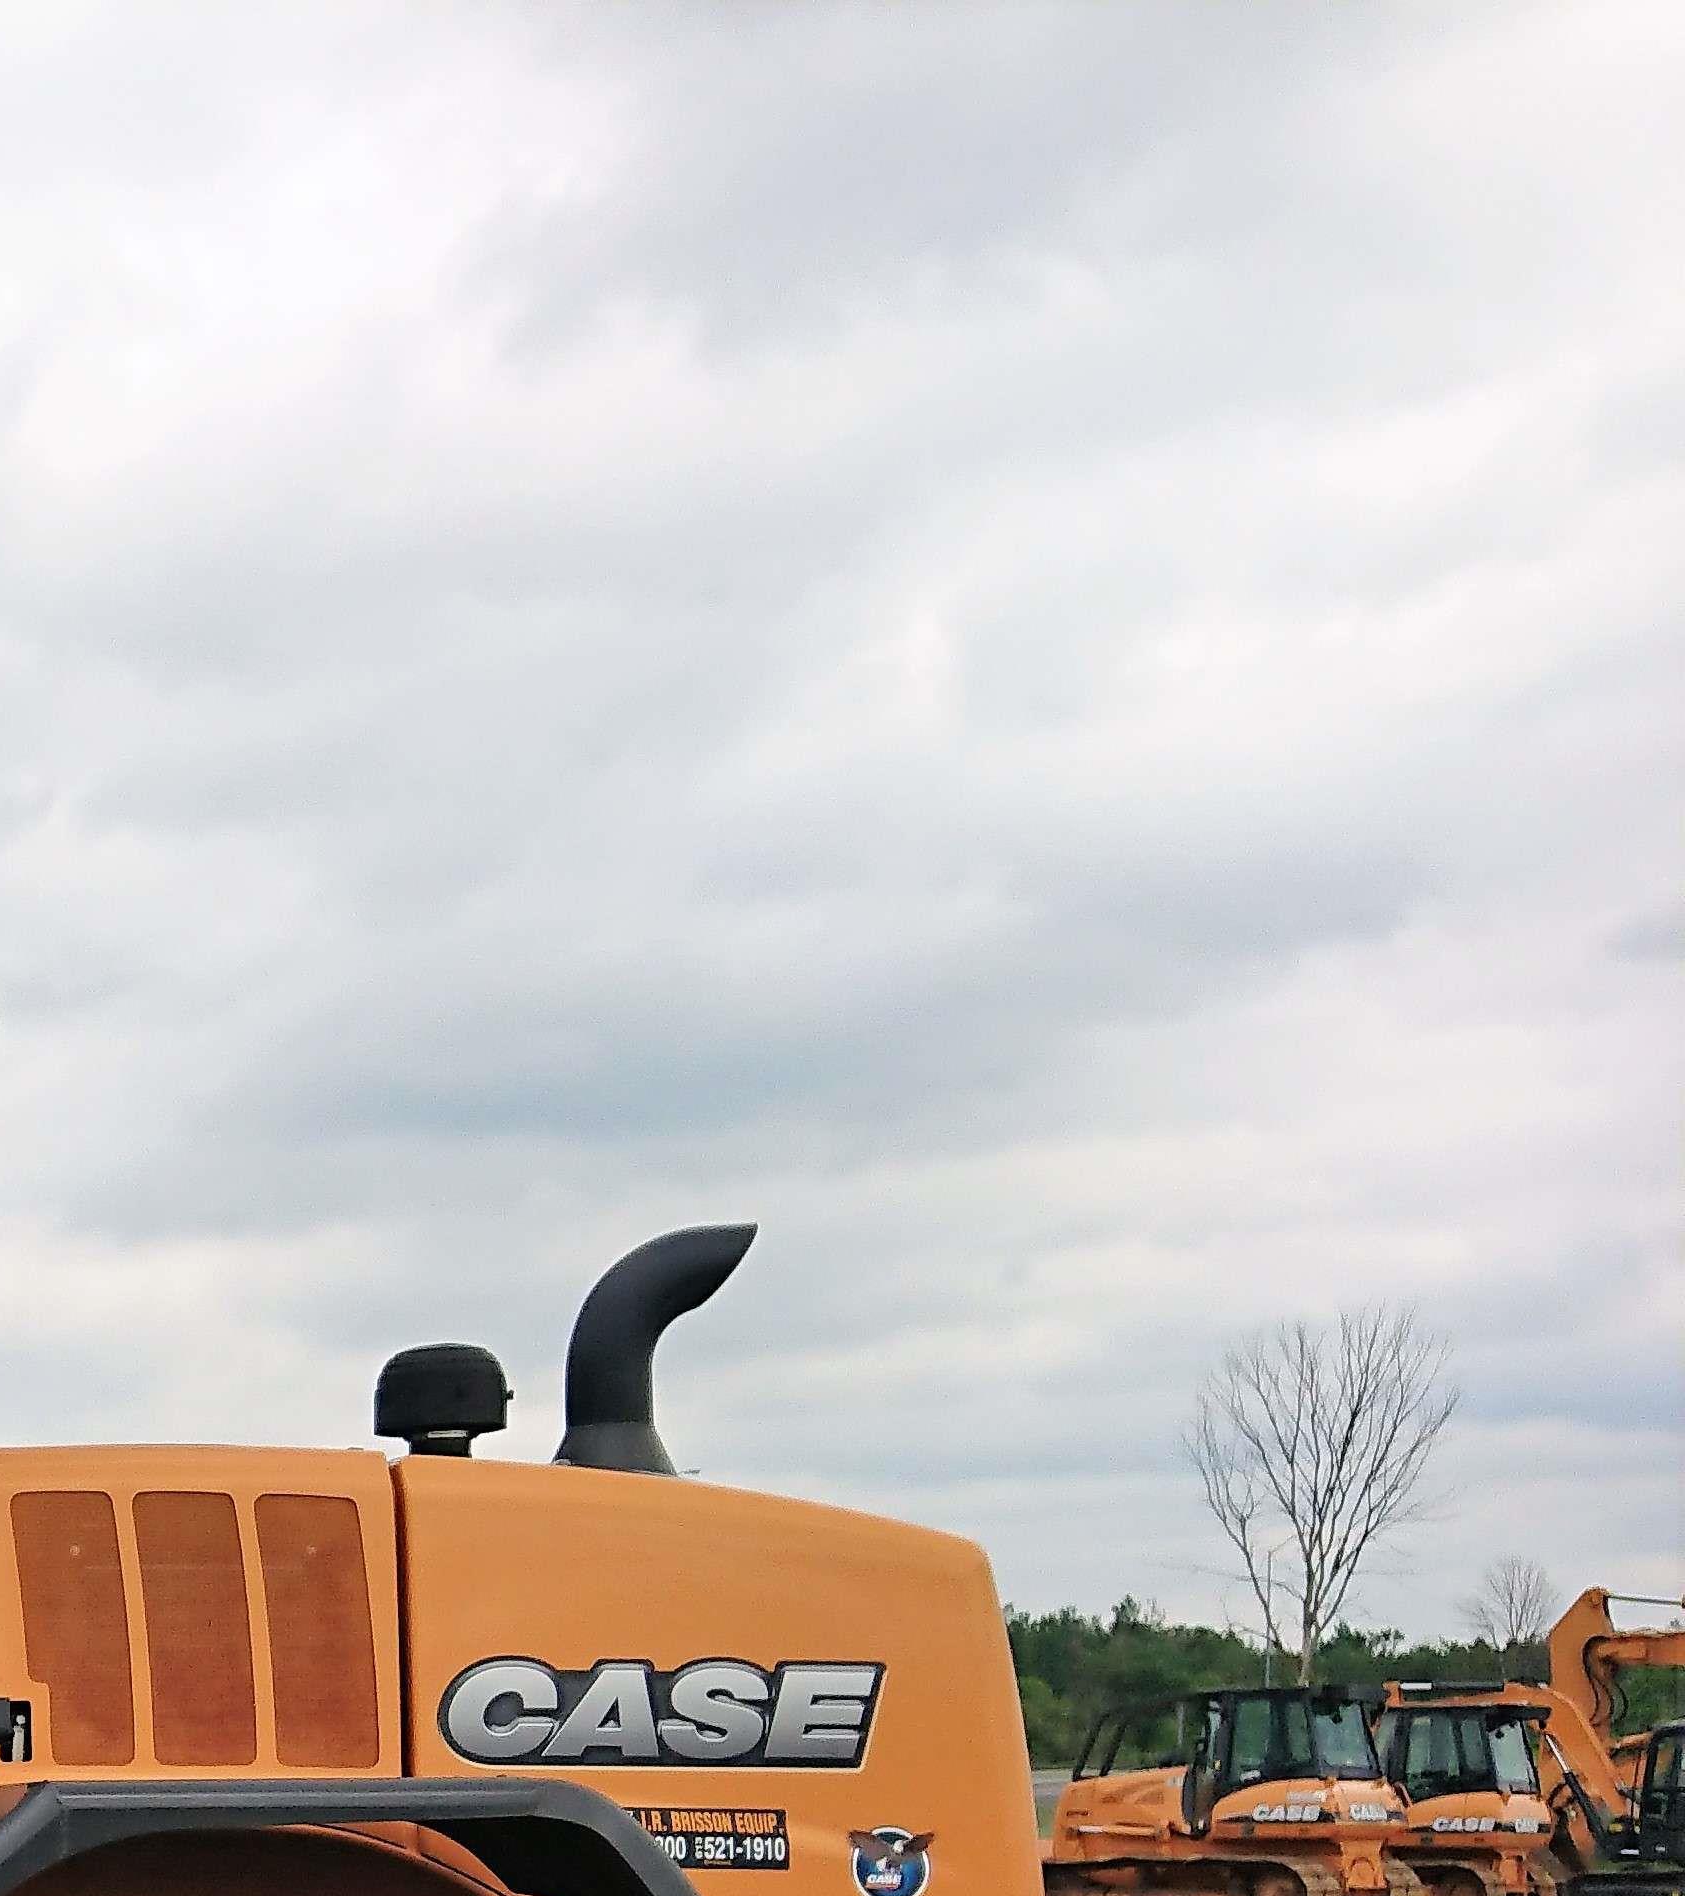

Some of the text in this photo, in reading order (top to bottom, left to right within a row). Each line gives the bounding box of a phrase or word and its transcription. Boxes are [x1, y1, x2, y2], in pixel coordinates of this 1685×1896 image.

[441, 1658, 882, 1765] CASE
[670, 1811, 733, 1833] BRISSON
[734, 1812, 785, 1835] EQUIP.
[703, 1836, 786, 1862] 521-1910
